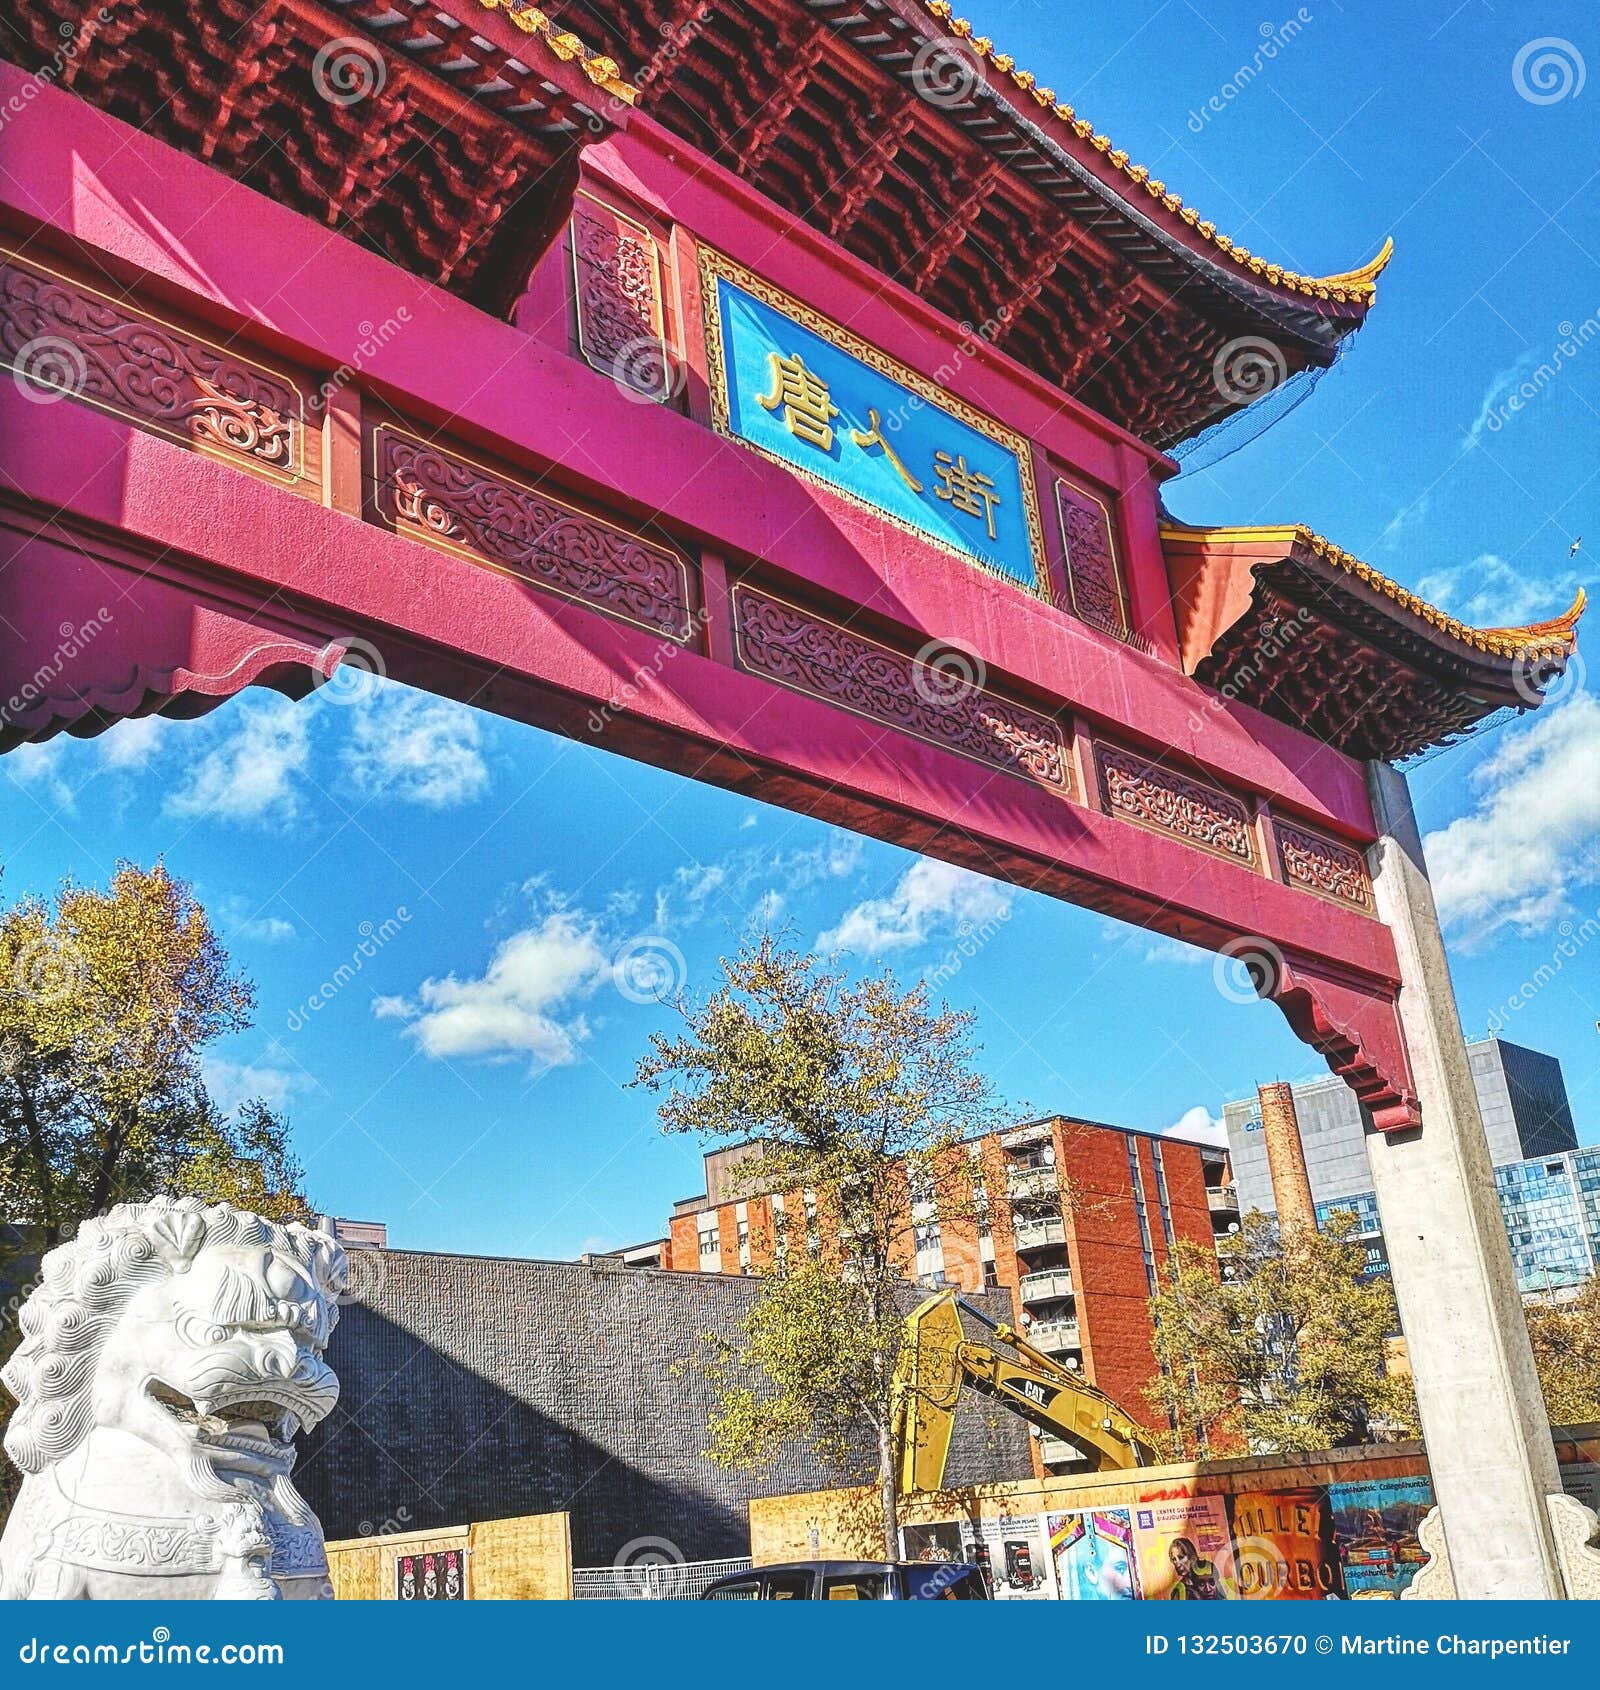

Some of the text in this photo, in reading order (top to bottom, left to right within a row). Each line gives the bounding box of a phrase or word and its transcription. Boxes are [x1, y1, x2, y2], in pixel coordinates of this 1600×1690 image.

[756, 352, 1000, 540] 唐人街
[1363, 1263, 1389, 1274] CHUM
[1025, 1381, 1045, 1404] CAT
